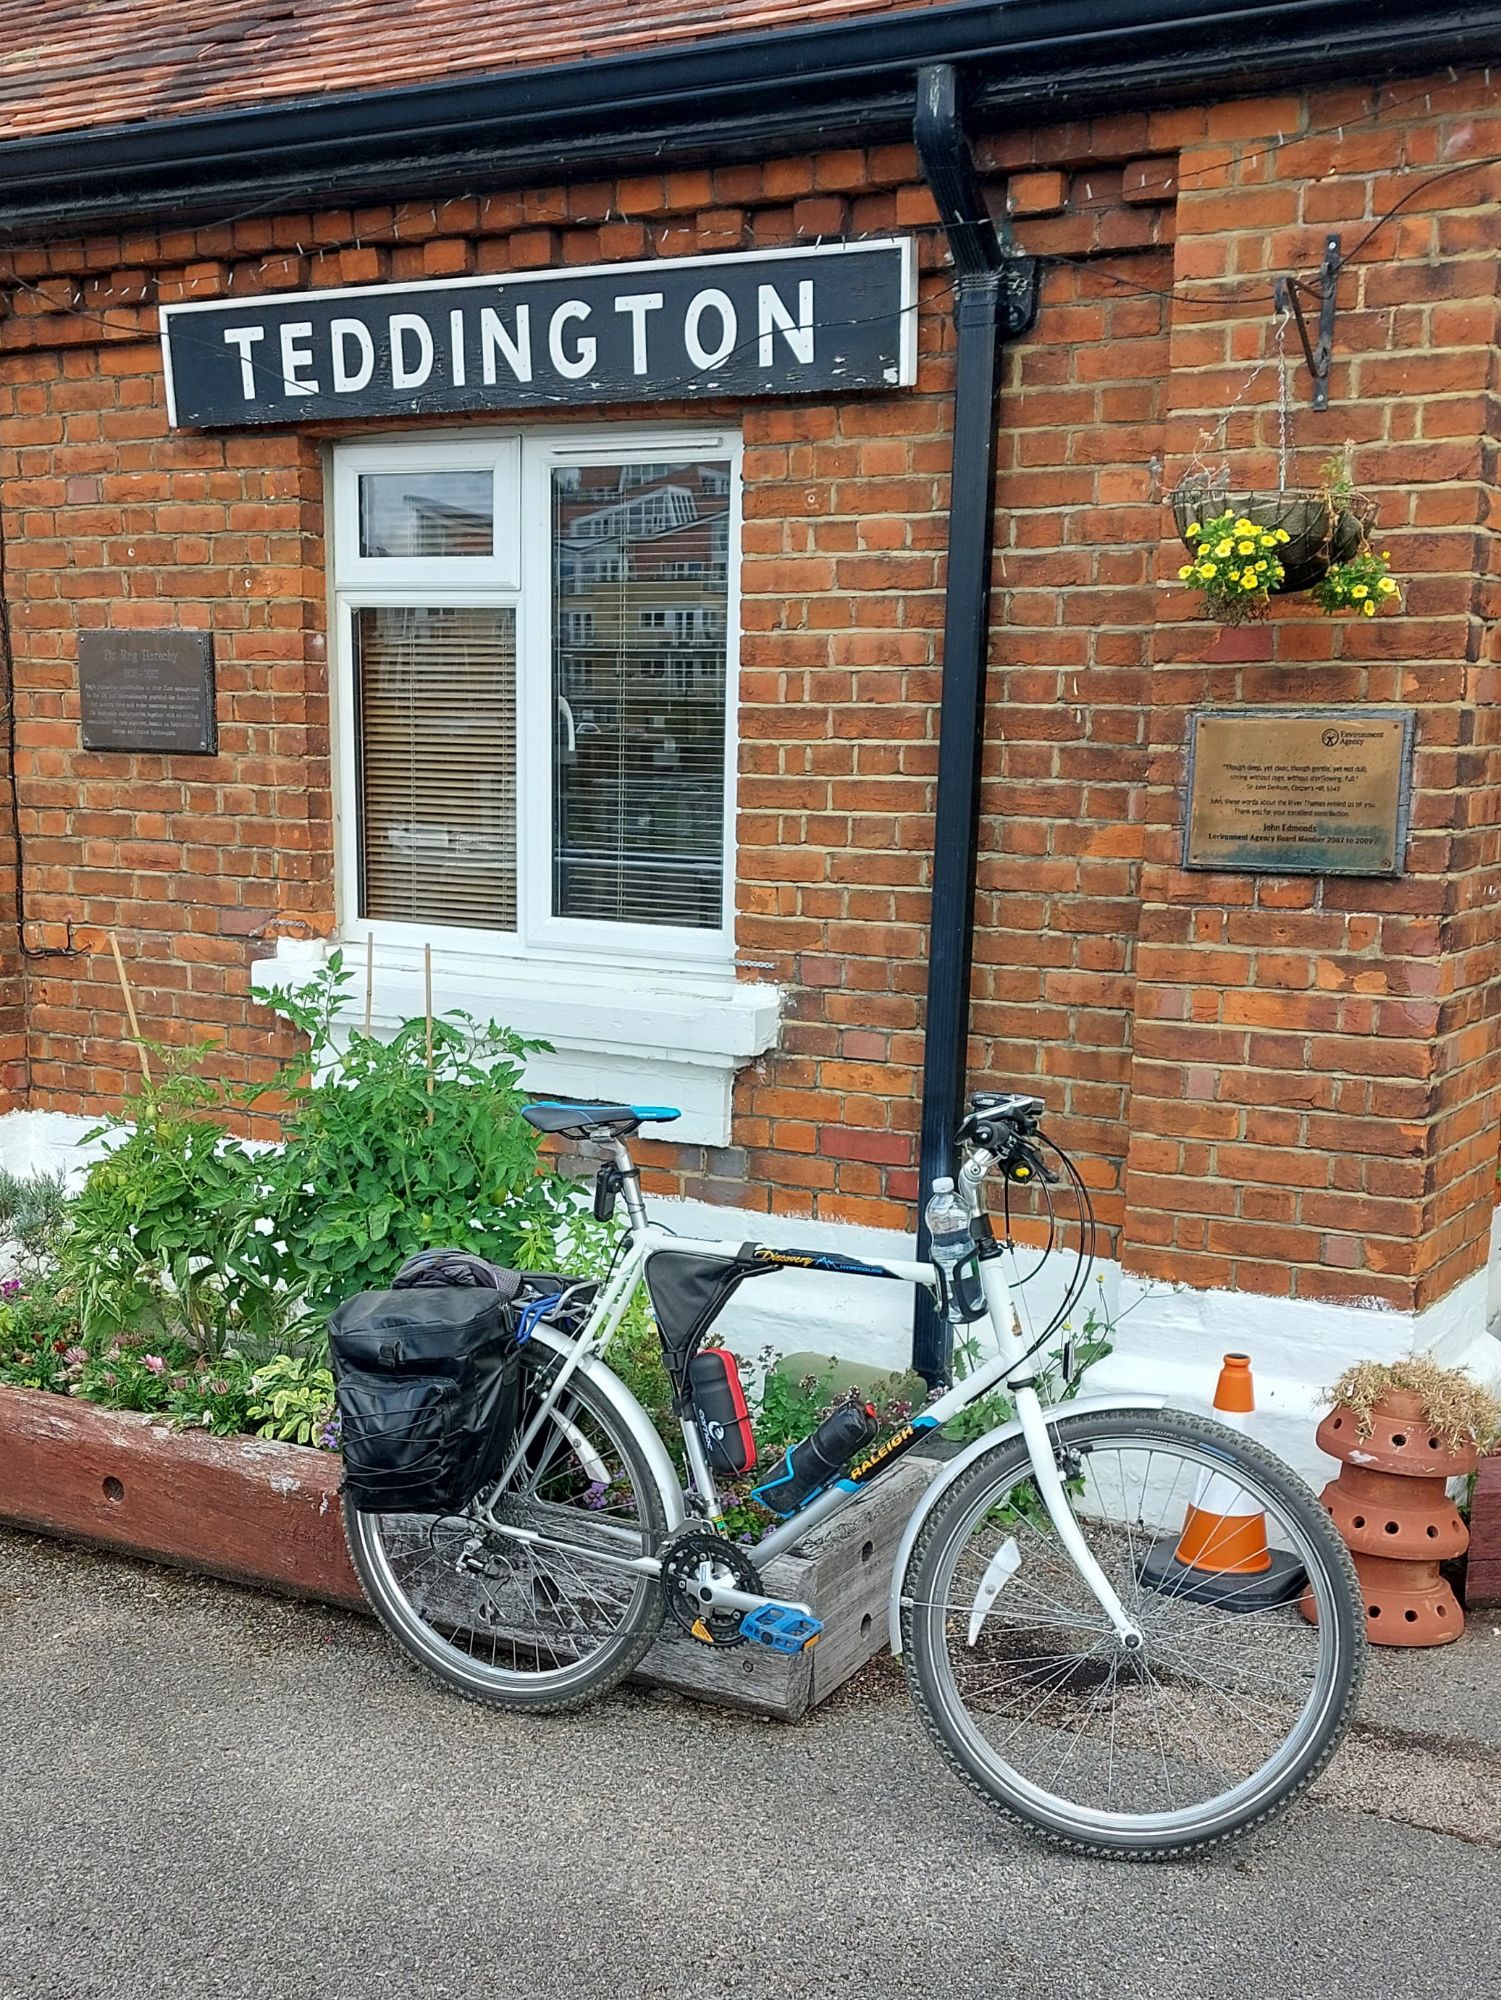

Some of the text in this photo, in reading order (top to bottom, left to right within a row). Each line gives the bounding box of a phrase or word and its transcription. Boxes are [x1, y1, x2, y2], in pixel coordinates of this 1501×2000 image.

[223, 280, 814, 400] TEDDINGTON
[1340, 738, 1364, 746] Agency
[1264, 823, 1317, 833] John Edmonds
[1208, 833, 1248, 841] Environment
[1250, 834, 1275, 843] Agency
[754, 1250, 814, 1267] Discovery
[850, 1424, 915, 1481] RALEIGH
